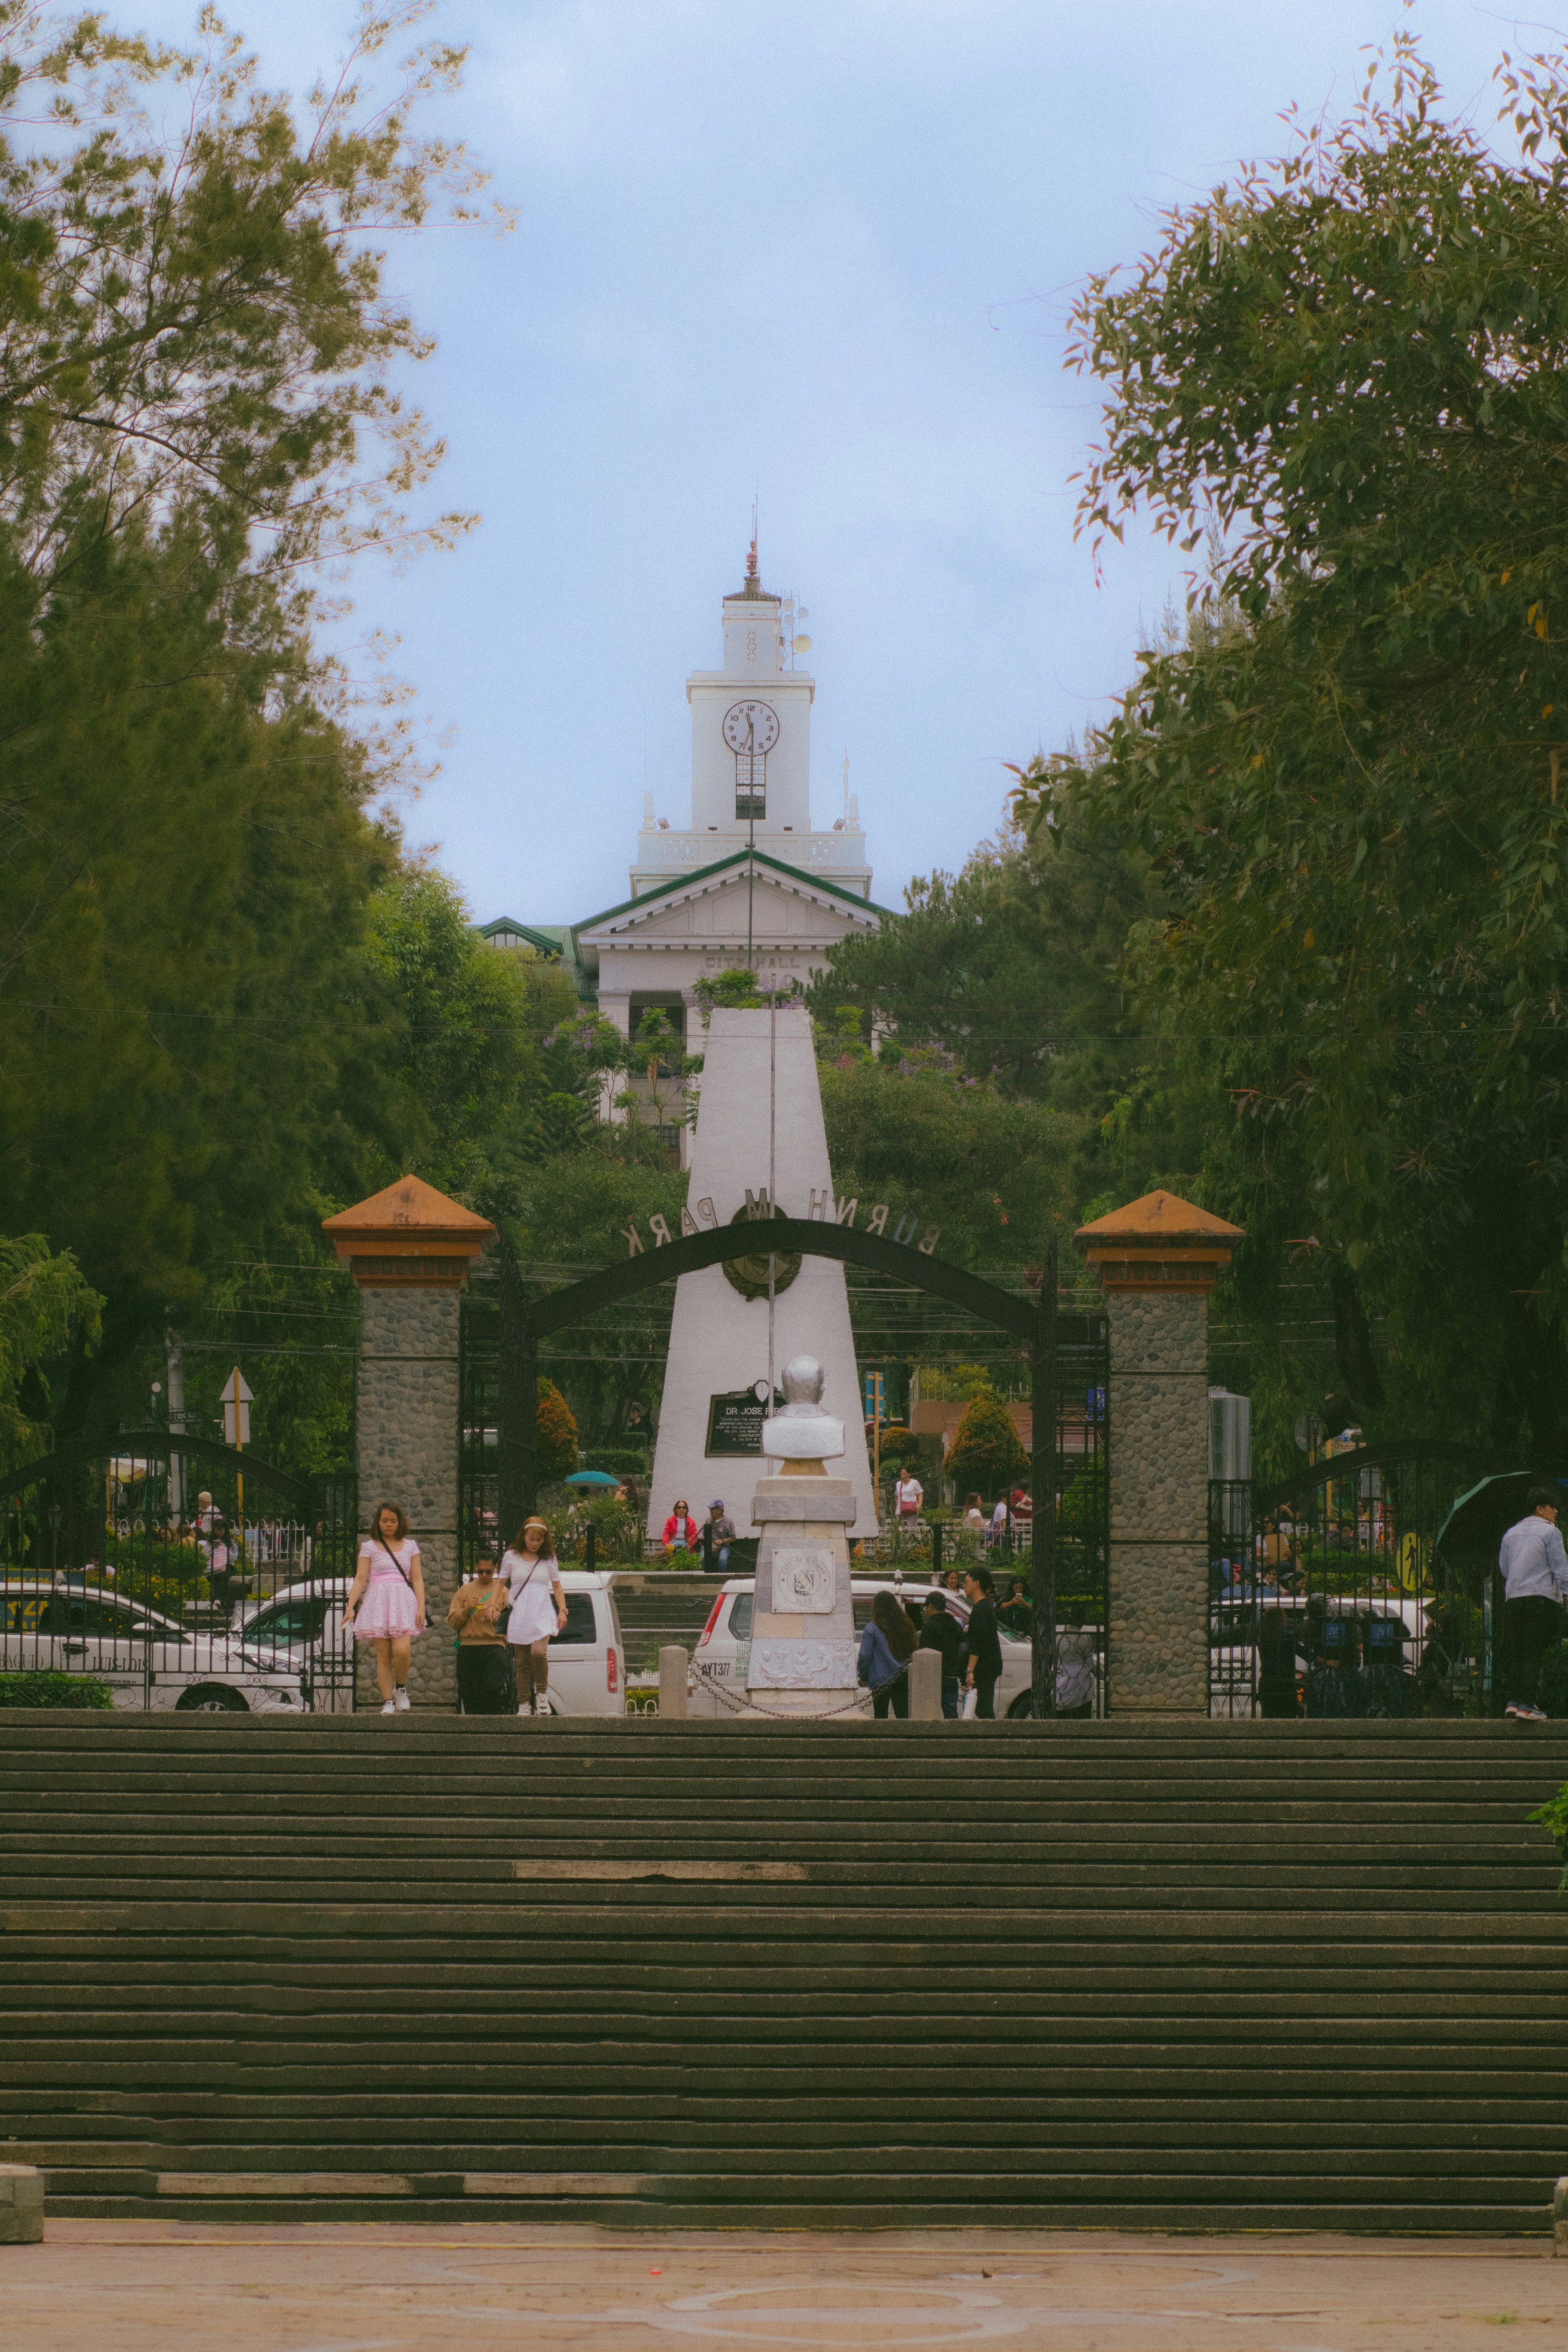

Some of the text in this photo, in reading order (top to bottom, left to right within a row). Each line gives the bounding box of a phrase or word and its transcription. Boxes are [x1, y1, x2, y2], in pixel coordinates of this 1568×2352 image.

[706, 957, 800, 969] CITY HALL
[702, 1663, 730, 1676] AYT377
